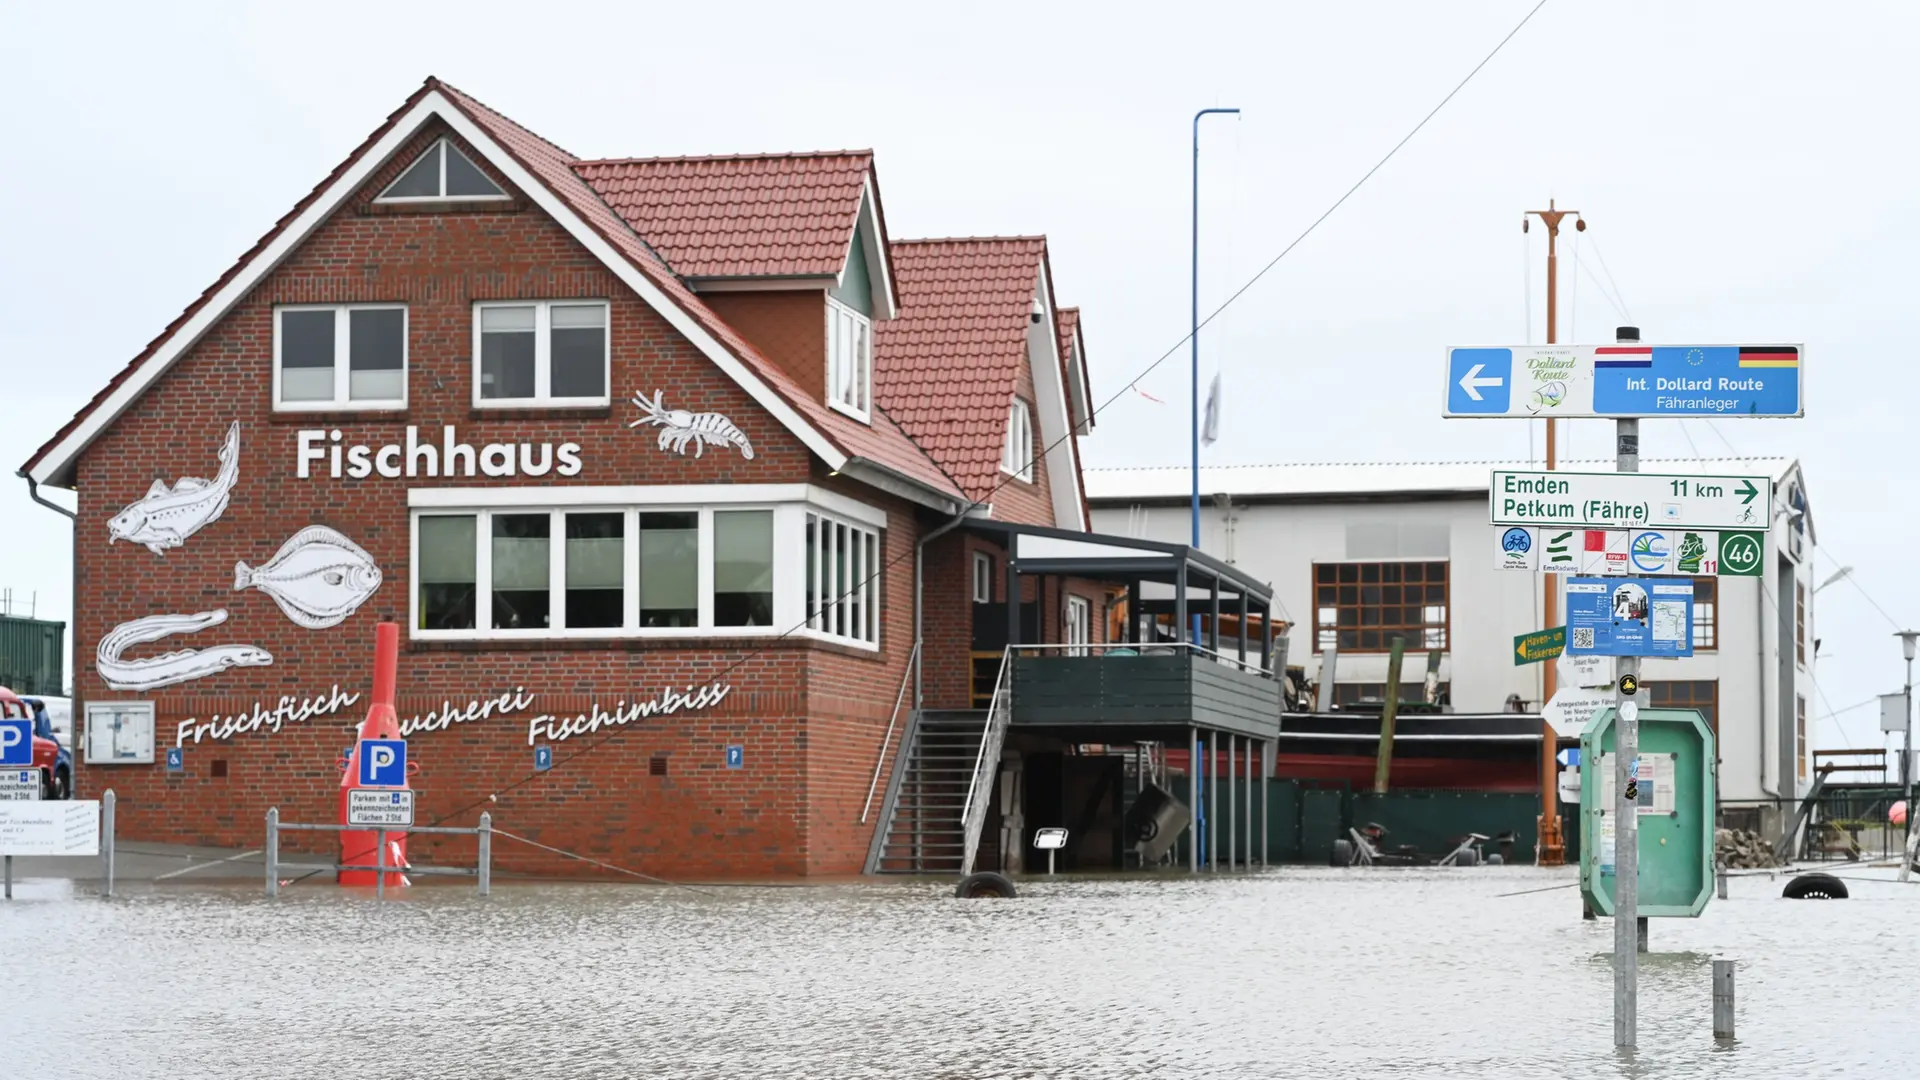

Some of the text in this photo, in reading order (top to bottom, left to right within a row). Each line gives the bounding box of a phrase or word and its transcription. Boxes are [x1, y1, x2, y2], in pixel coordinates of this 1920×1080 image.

[1526, 356, 1576, 369] Dollard
[1532, 369, 1569, 382] Route
[1626, 377, 1764, 391] Int. Dollard Route
[1656, 396, 1740, 412] Fähranleger
[297, 425, 582, 478] Fischhaus
[1504, 475, 1723, 498] Emden 11 km
[1504, 499, 1649, 524] Petkum (Fähre)
[1728, 544, 1754, 563] 46
[1704, 561, 1716, 573] 11
[1526, 635, 1551, 646] Haven-
[1556, 700, 1589, 708] Anlegestelle
[176, 683, 731, 748] Frischfisch ucherei Fischimbiss
[0, 725, 22, 760] P
[370, 745, 395, 780] P
[353, 794, 377, 802] Parken
[379, 794, 390, 802] mit
[352, 804, 410, 812] gekennzeichneten
[357, 813, 382, 821] Flächen
